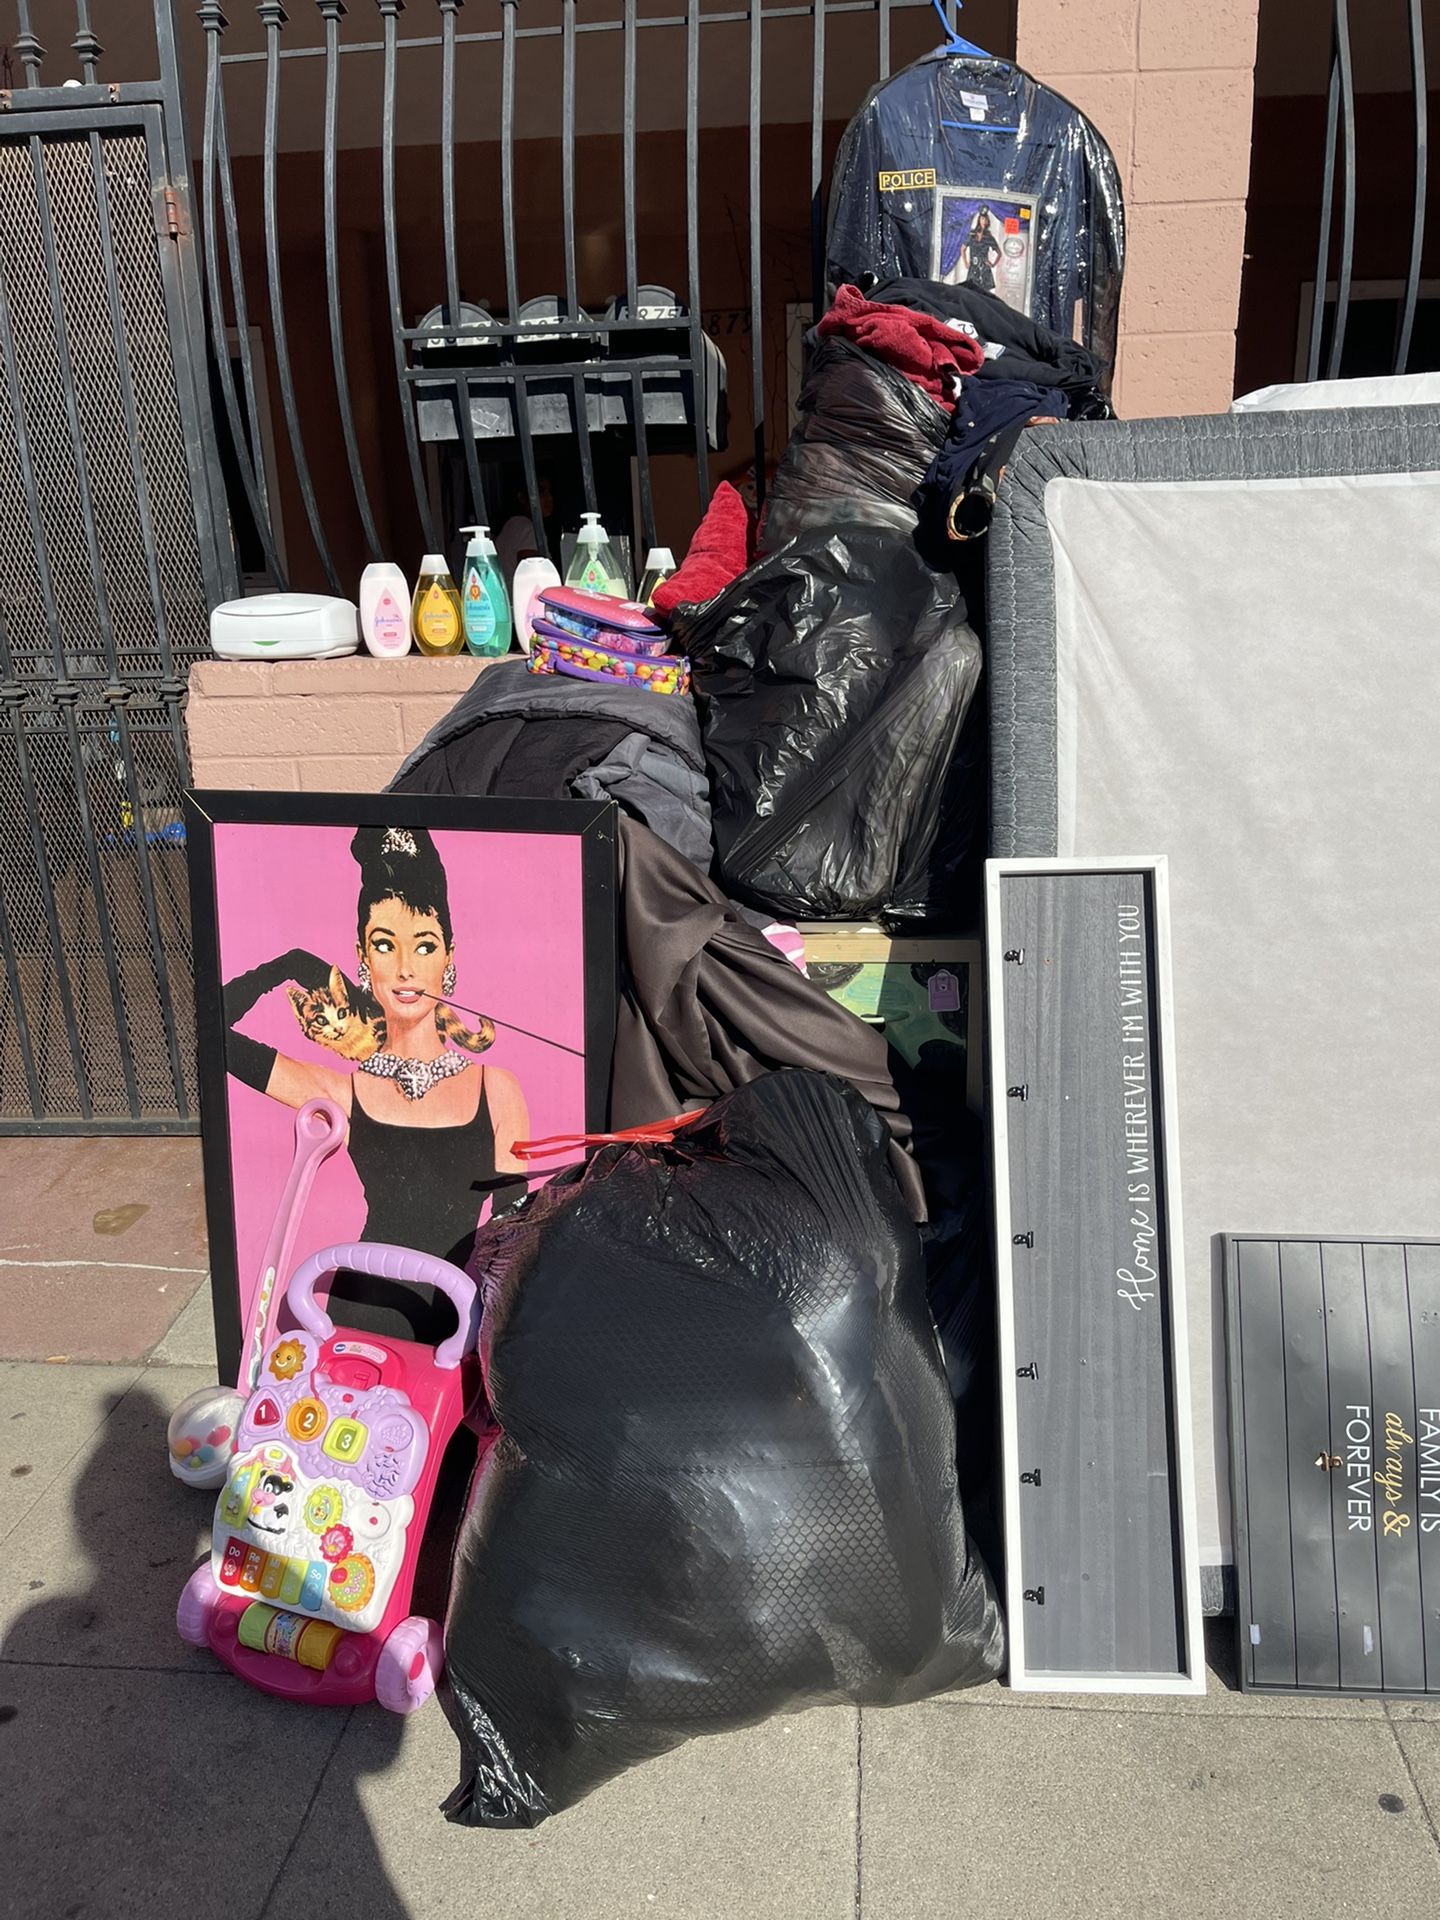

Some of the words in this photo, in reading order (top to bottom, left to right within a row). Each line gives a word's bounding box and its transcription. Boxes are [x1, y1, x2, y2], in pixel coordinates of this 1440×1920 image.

[882, 171, 933, 187] POLICE
[1117, 904, 1141, 943] YOU
[1119, 951, 1143, 1006] WITH
[1122, 1015, 1144, 1042] I'M
[1122, 1052, 1150, 1175] WHEREVER
[1127, 1183, 1151, 1201] IS
[1116, 1209, 1157, 1311] Home
[259, 1404, 266, 1419] 1
[303, 1412, 314, 1428] 2
[341, 1434, 352, 1449] 3
[1373, 1412, 1414, 1507] always
[1419, 1408, 1440, 1502] FAMILY
[1345, 1405, 1371, 1531] FOREVER
[1382, 1510, 1411, 1537] &
[1420, 1512, 1440, 1533] IS
[228, 1546, 241, 1557] Do
[249, 1552, 260, 1563] Re
[310, 1568, 322, 1580] So
